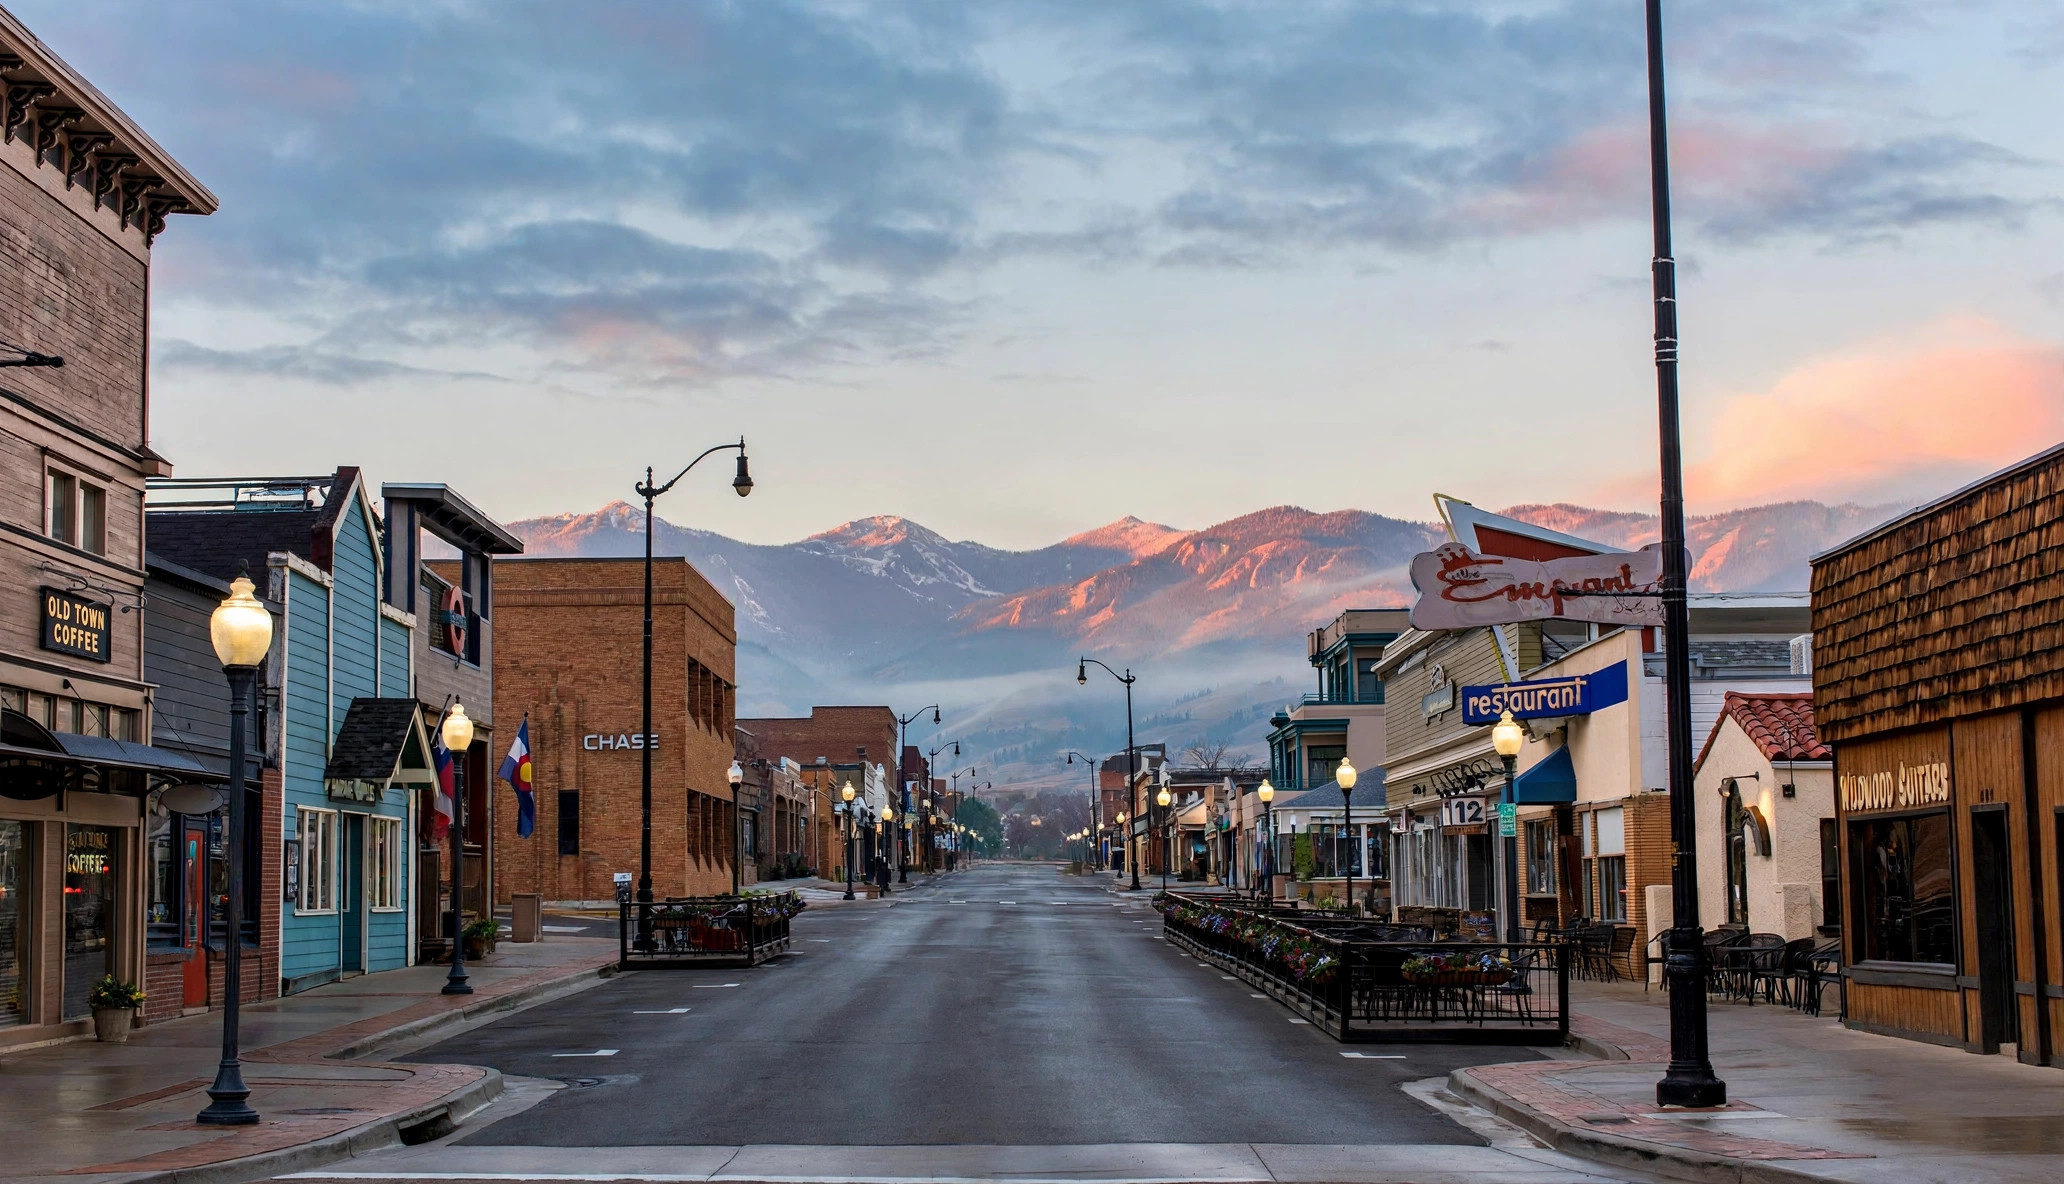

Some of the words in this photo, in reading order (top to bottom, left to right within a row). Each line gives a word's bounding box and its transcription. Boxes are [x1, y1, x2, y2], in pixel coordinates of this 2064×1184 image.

[48, 595, 71, 621] OLD
[74, 603, 105, 631] TOWN
[54, 622, 99, 653] COFFEE
[1468, 677, 1587, 717] restaurant
[583, 733, 659, 751] CHASE
